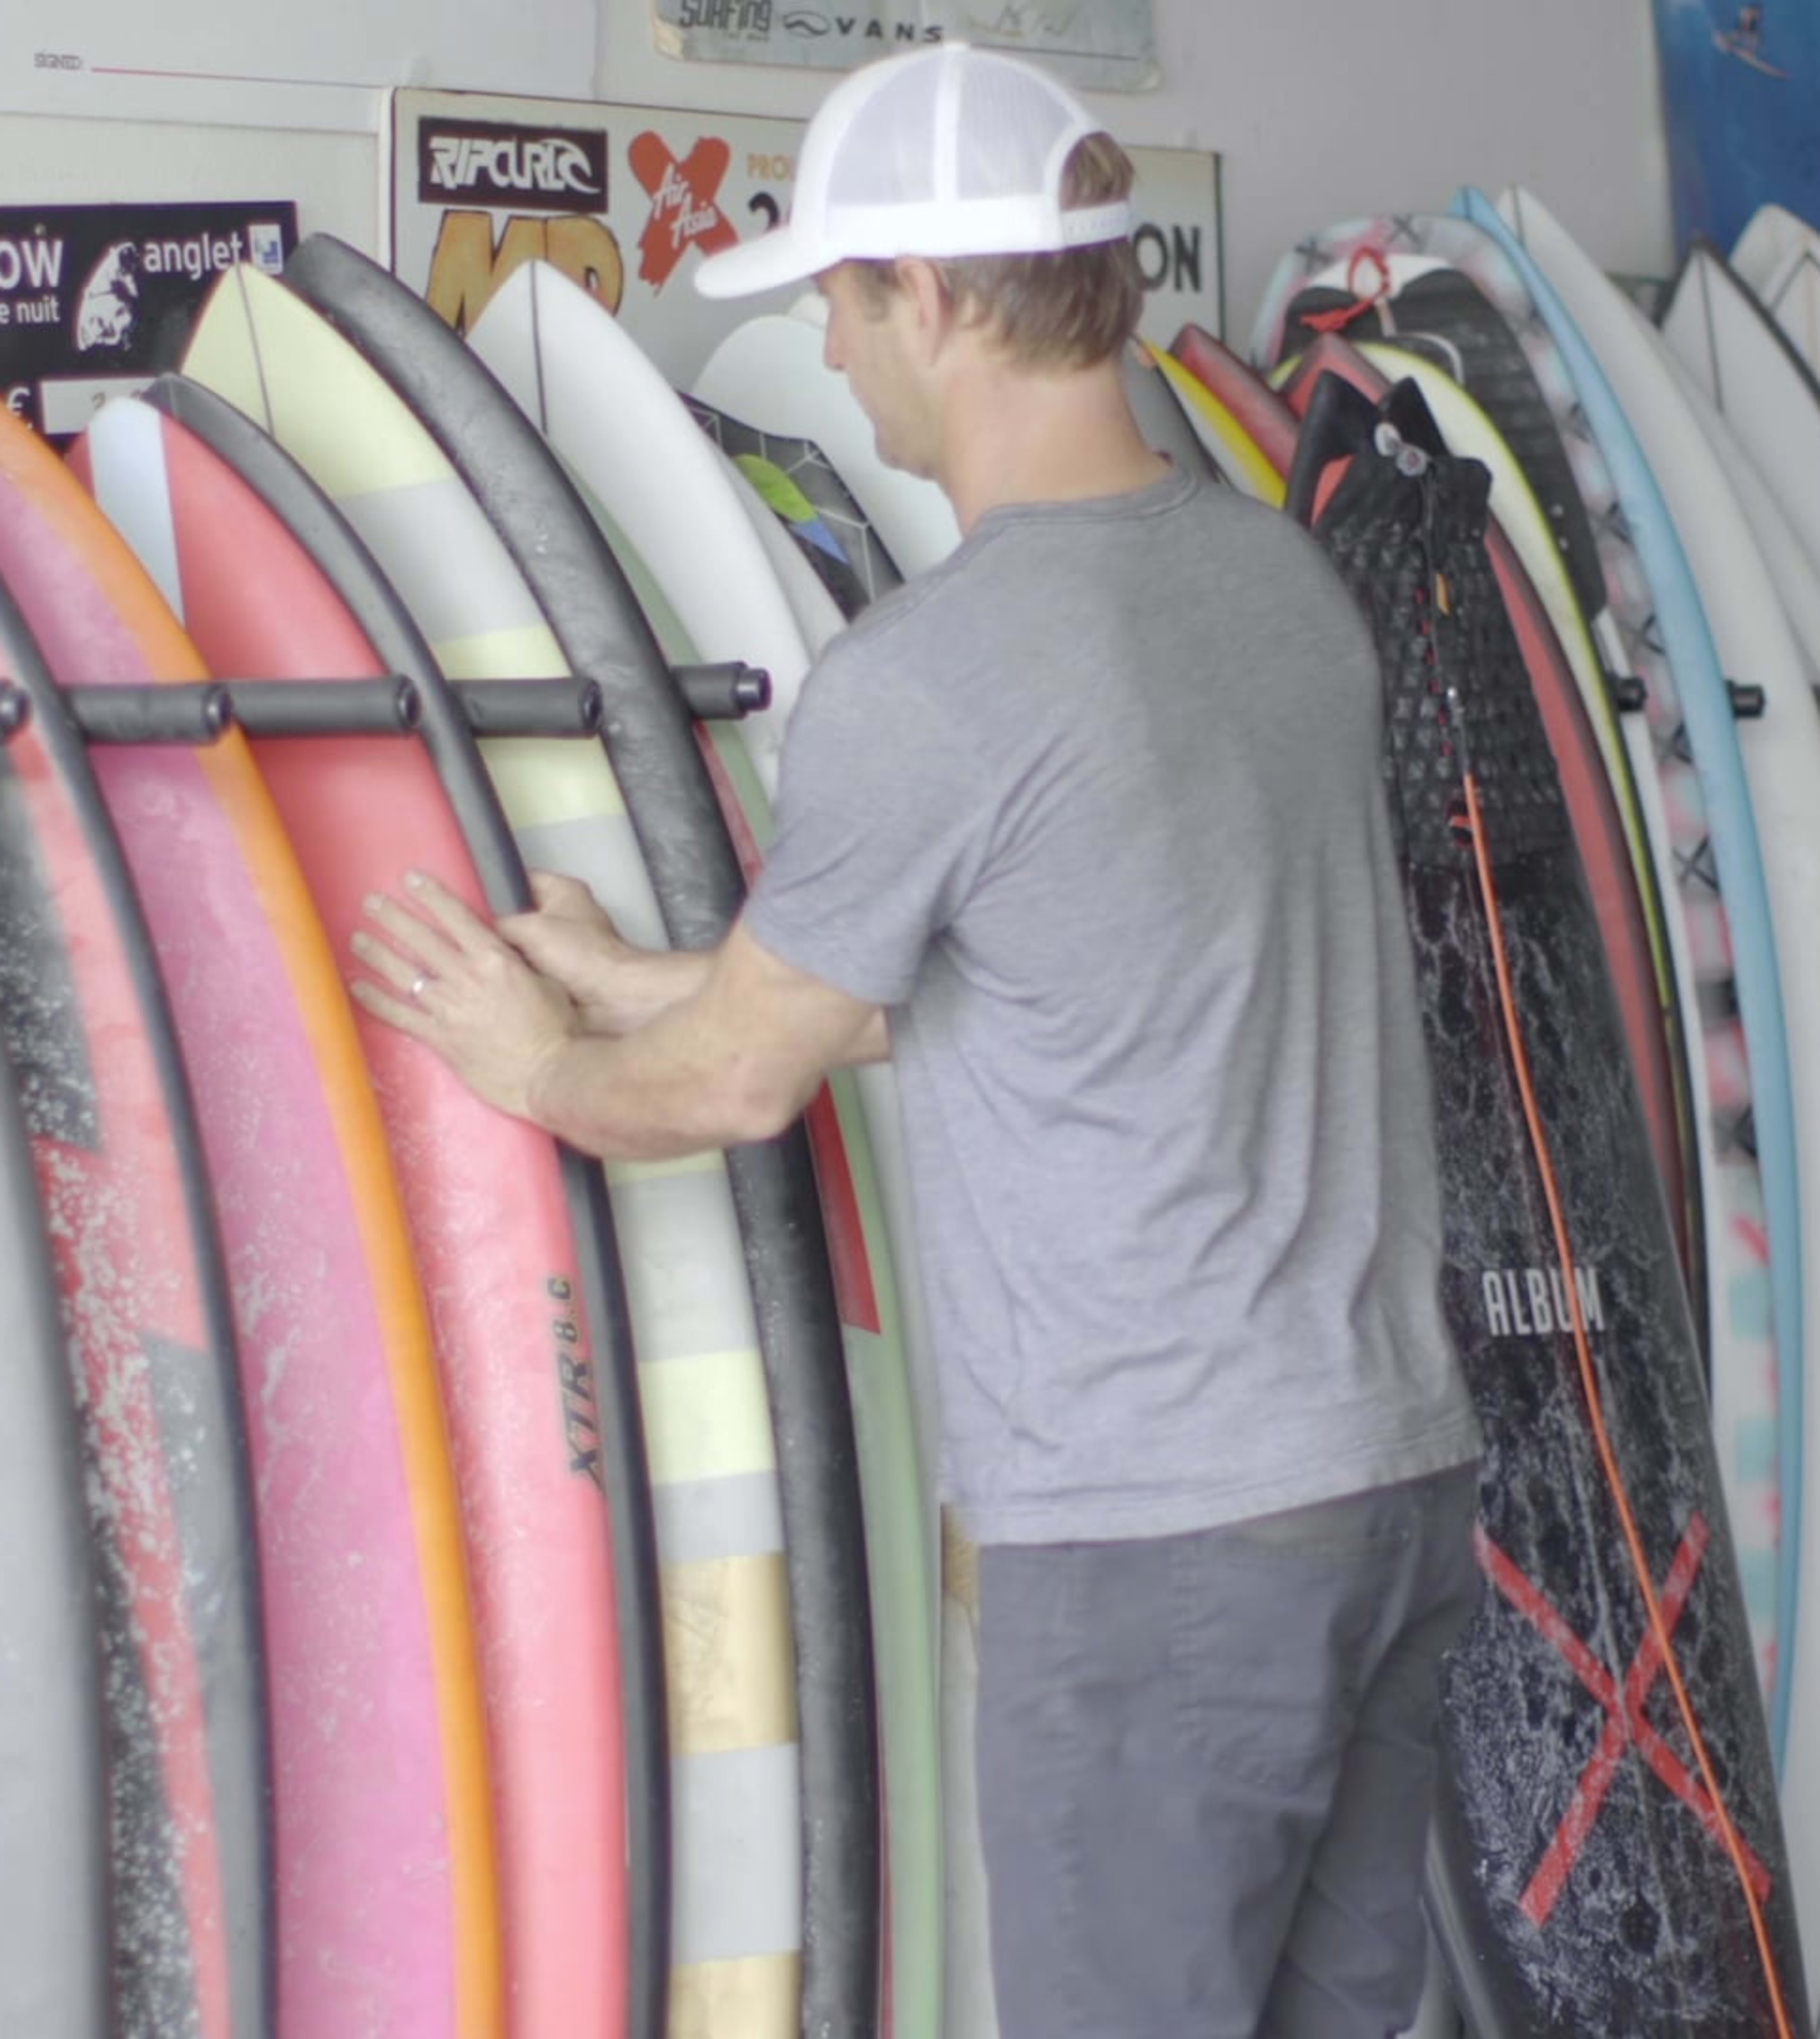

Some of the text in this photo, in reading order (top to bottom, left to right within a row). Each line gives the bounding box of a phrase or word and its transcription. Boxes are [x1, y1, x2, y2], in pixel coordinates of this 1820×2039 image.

[835, 17, 944, 44] VANS
[653, 163, 690, 220] Air
[747, 152, 797, 183] PRO
[671, 191, 718, 250] Asia
[144, 232, 243, 280] anglet
[17, 295, 60, 323] nuit
[1482, 1266, 1604, 1336] ALBUM
[558, 1353, 604, 1494] XTR
